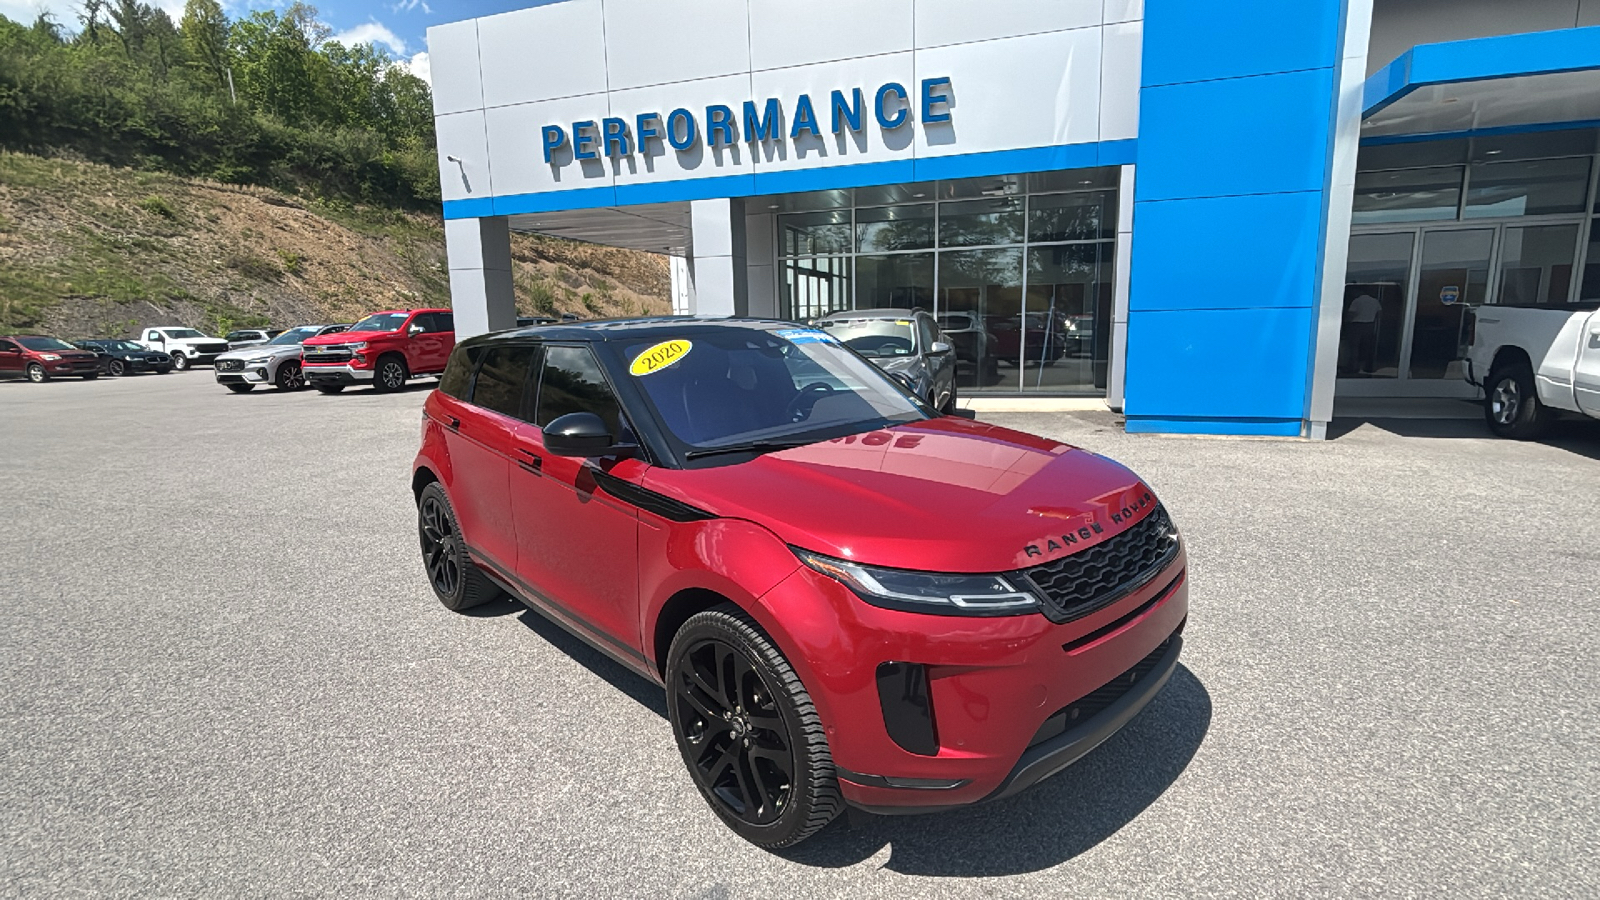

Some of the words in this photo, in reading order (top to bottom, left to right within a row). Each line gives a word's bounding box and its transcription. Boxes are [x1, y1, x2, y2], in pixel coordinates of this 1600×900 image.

[542, 76, 951, 163] PERFORMANCE
[641, 343, 682, 370] 2020
[1023, 522, 1104, 557] RANGE
[1111, 492, 1151, 525] ROVER
